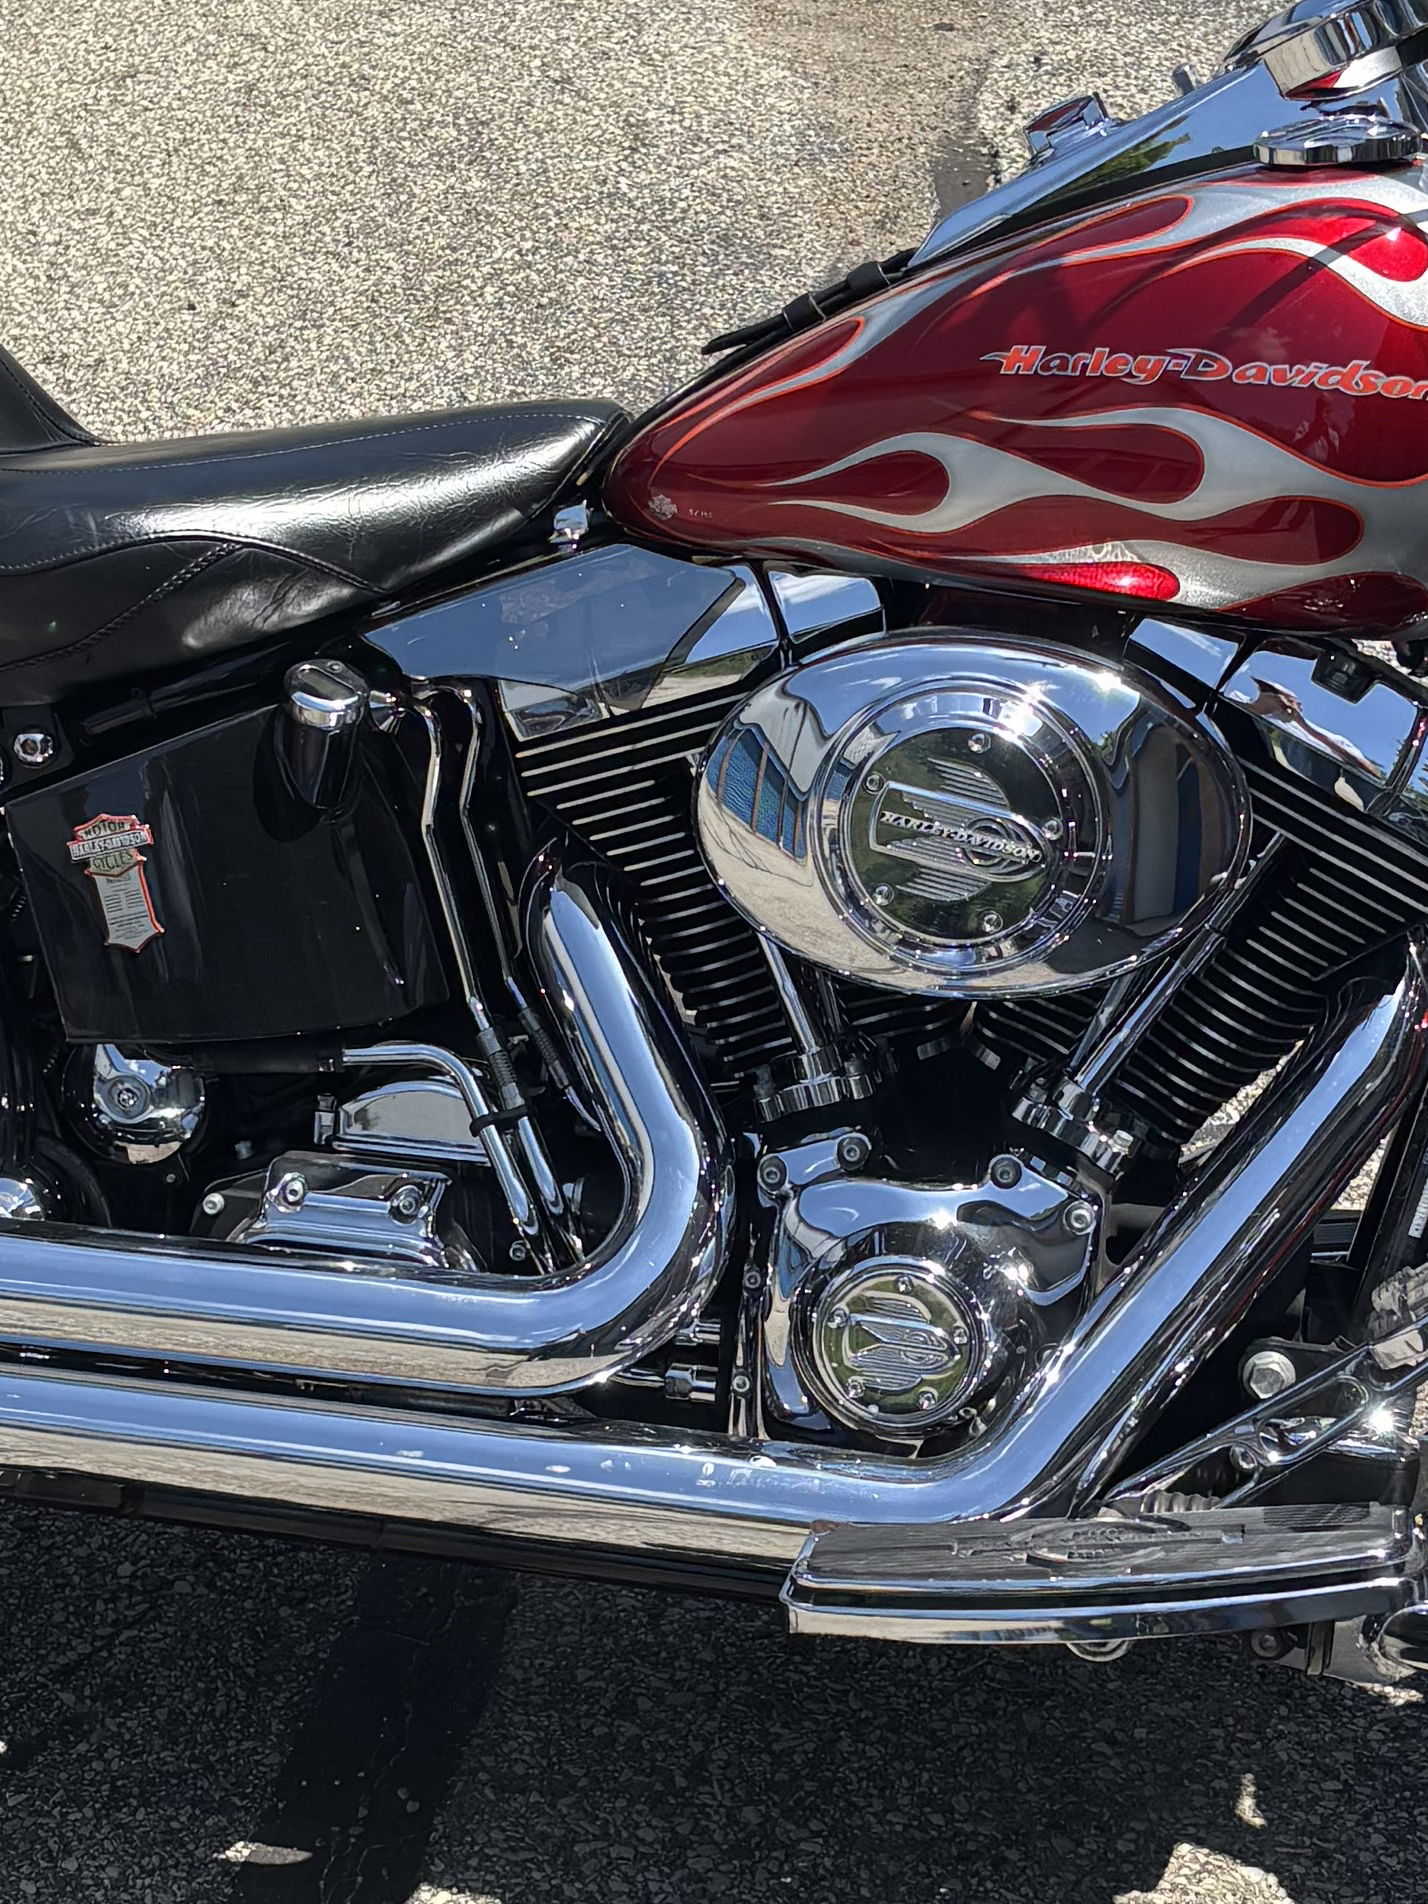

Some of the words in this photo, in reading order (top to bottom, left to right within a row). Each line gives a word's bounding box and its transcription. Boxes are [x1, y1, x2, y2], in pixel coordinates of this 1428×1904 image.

[83, 821, 127, 837] MOTOR
[880, 810, 1042, 865] HARLEY-DAVIDSON
[93, 850, 134, 871] CYCLES
